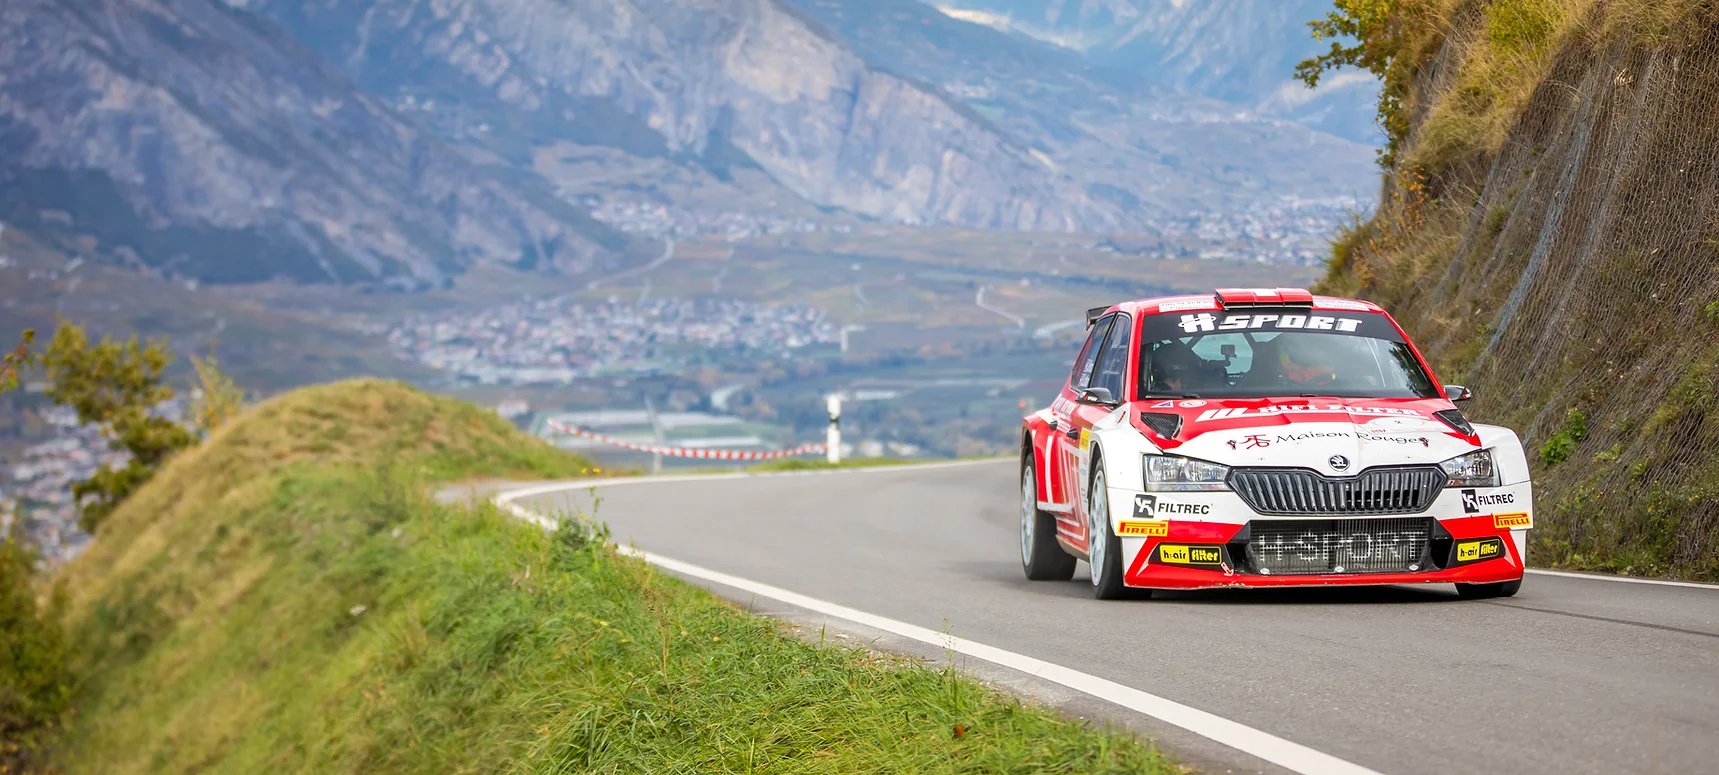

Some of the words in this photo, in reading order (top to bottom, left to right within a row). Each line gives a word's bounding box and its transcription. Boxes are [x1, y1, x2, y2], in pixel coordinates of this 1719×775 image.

[1218, 314, 1363, 332] SPORT
[1276, 431, 1350, 443] Maison
[1355, 430, 1420, 445] Rouge
[1478, 494, 1515, 506] FILTREC
[1158, 502, 1210, 515] FILTREC
[1495, 513, 1530, 526] PIRELLI
[1119, 522, 1166, 535] PIRELLI
